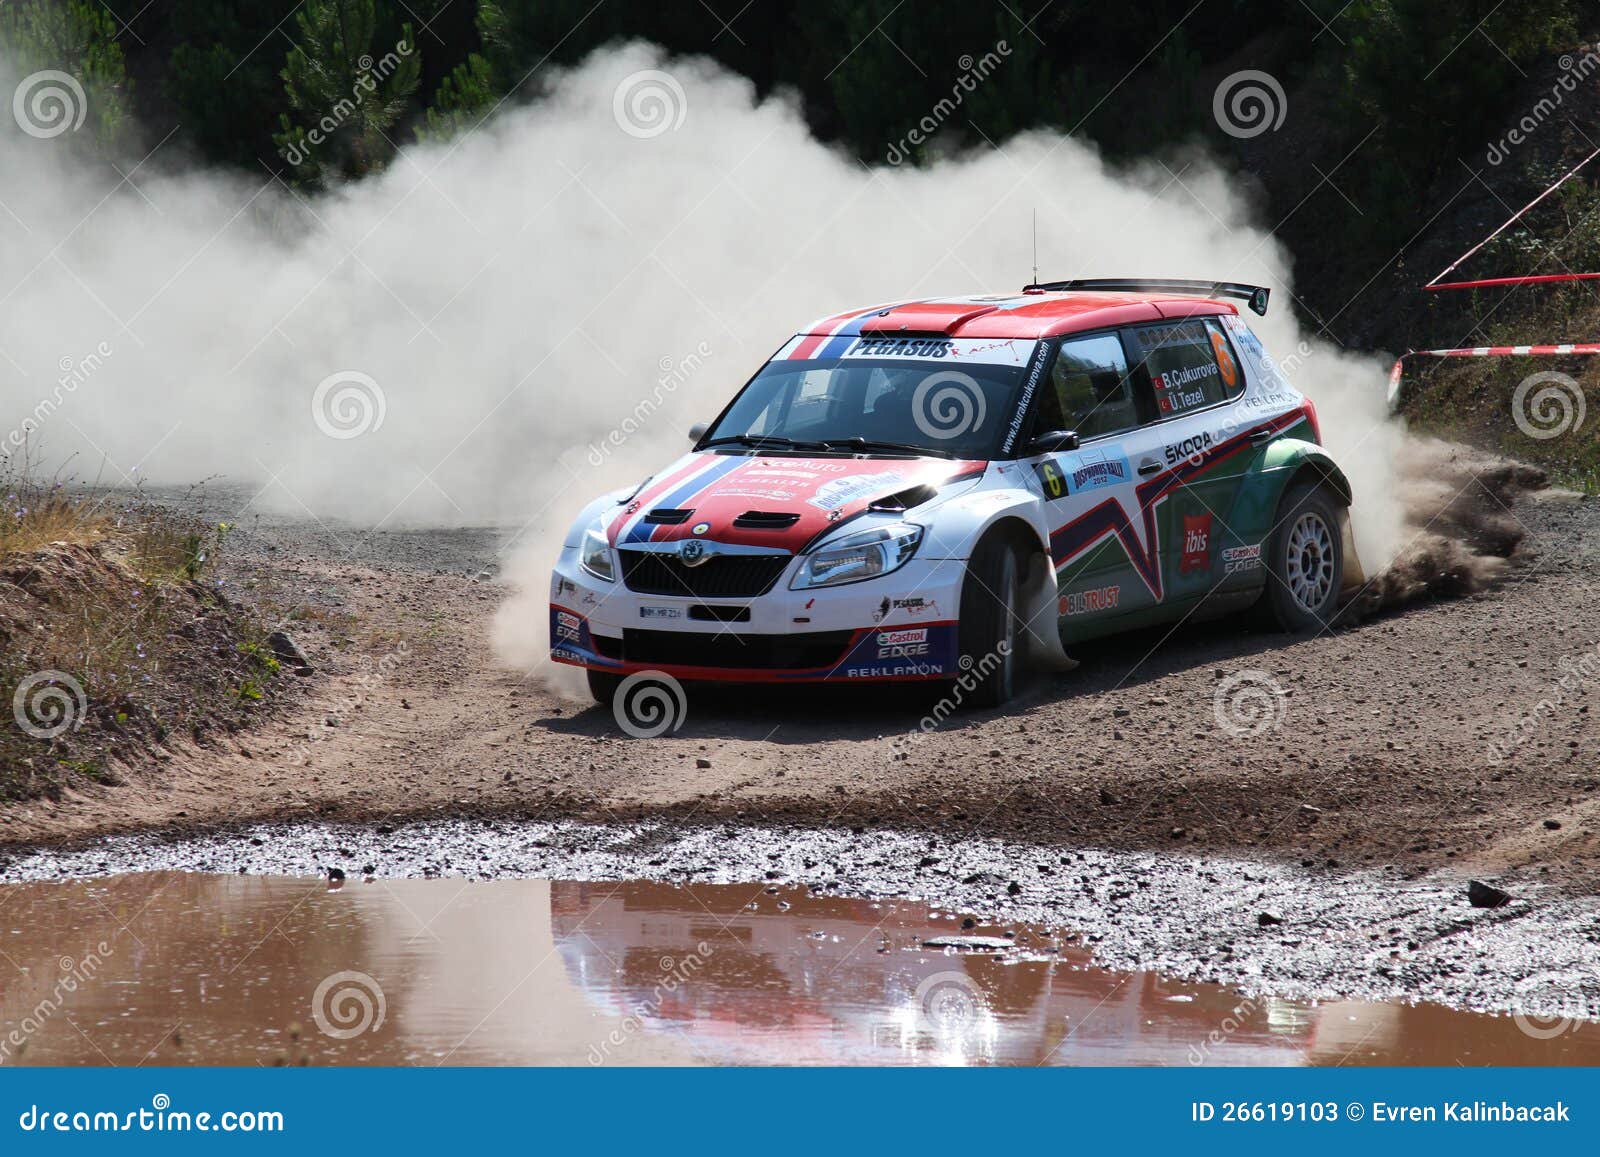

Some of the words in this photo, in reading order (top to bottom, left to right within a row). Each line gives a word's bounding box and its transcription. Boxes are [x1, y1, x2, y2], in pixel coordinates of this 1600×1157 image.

[848, 338, 954, 359] PEGASUS
[1210, 331, 1236, 388] 6
[1161, 362, 1219, 390] B.Çukurova
[1001, 341, 1050, 455] www.burakcukurova.com
[1169, 388, 1206, 411] Ü.Tezel
[1165, 431, 1213, 465] ŠKODA
[1044, 465, 1061, 497] 6
[1186, 528, 1208, 553] ibis
[1224, 558, 1262, 574] EDGE
[557, 626, 581, 642] EDGE
[888, 631, 925, 644] Castrol
[877, 643, 930, 660] EDGE
